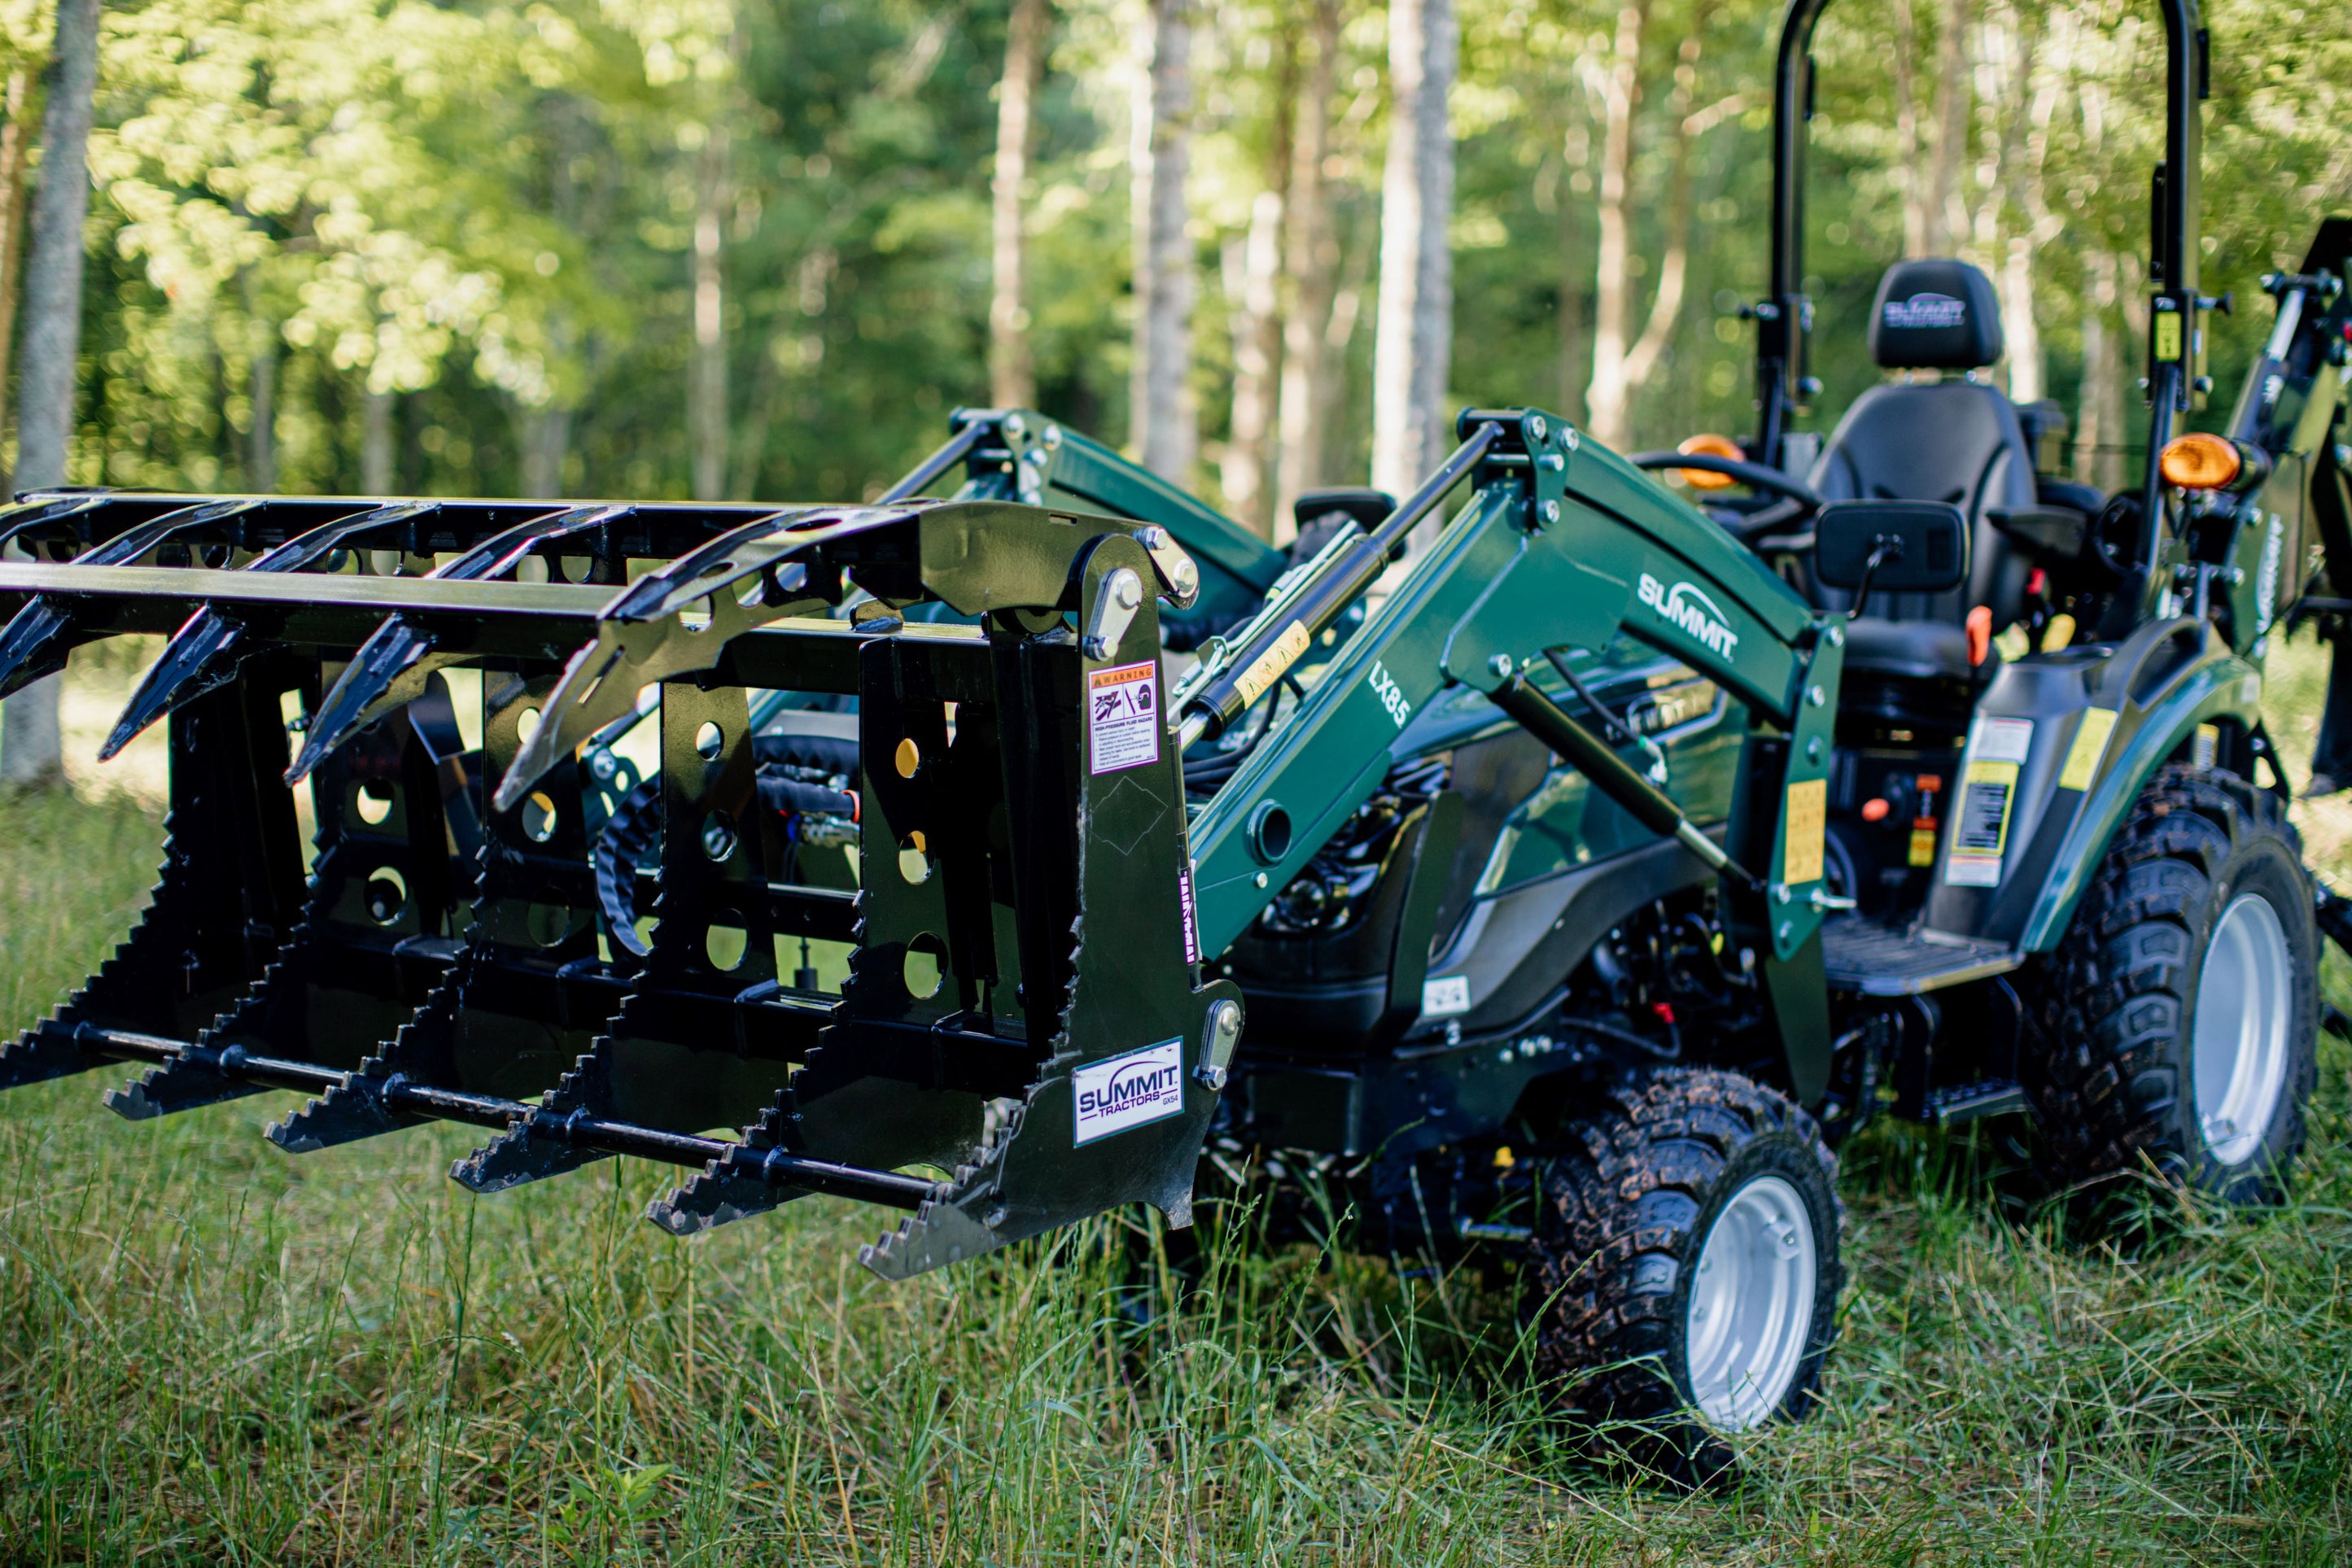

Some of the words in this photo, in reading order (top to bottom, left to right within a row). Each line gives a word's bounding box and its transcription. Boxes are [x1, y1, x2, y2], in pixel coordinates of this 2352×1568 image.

[1637, 573, 1738, 659] SUMMIT
[1104, 668, 1152, 684] WARNING
[1368, 660, 1410, 727] LX85
[1079, 1061, 1178, 1113] SUMMIT
[1099, 1090, 1161, 1118] TRACTORS
[1162, 1094, 1178, 1106] GX54
